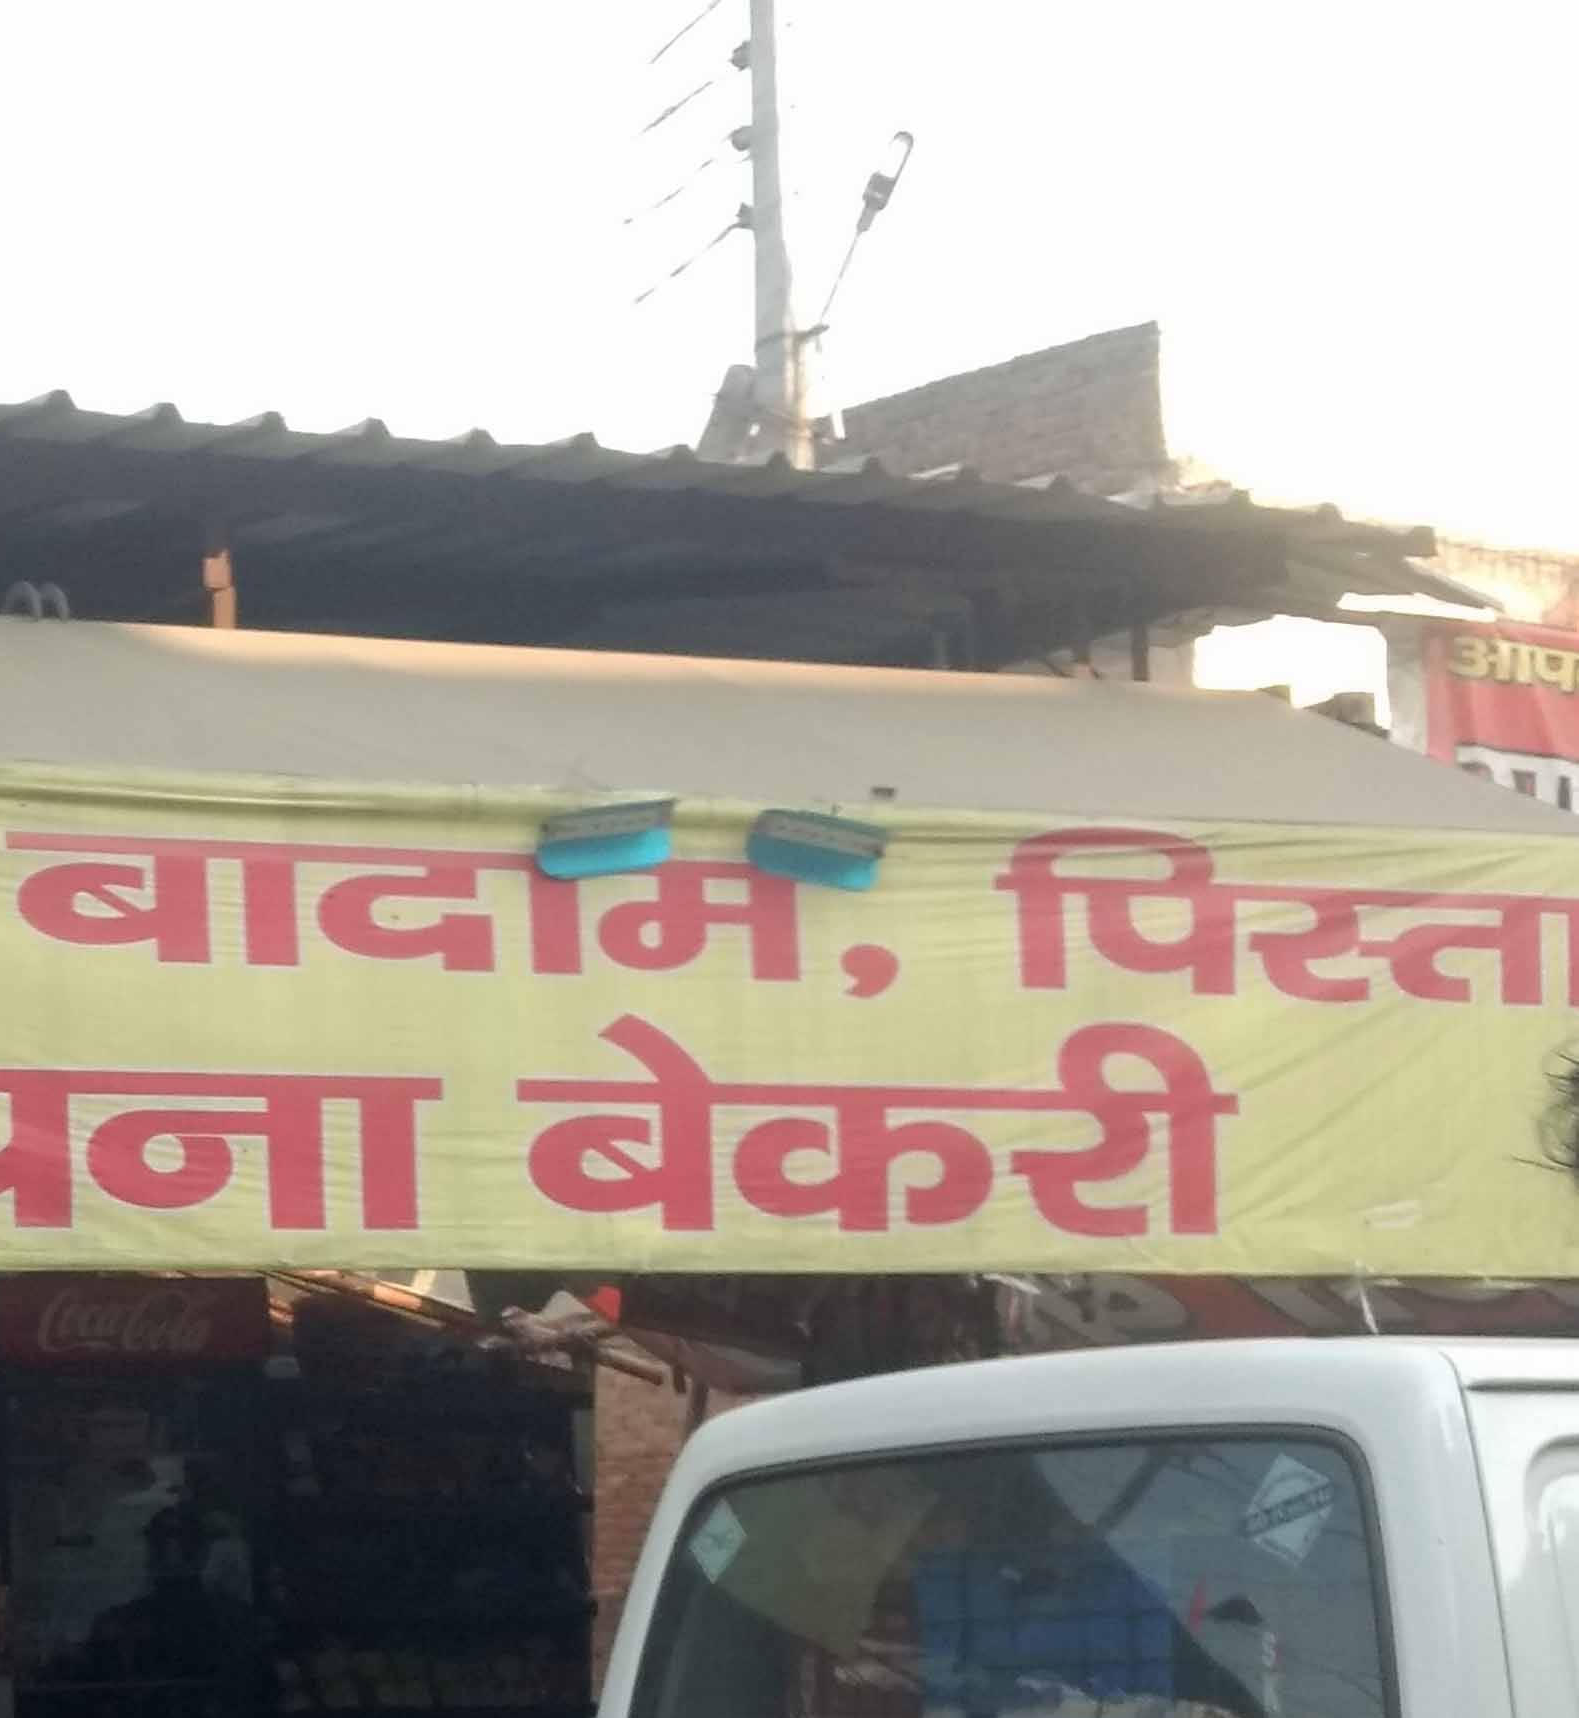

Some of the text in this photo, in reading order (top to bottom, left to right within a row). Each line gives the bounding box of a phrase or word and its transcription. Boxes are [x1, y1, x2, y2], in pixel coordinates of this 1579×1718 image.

[7, 832, 898, 998] बादाम,
[996, 829, 1579, 1006] पिस्त
[517, 1015, 1238, 1238] बेकरी
